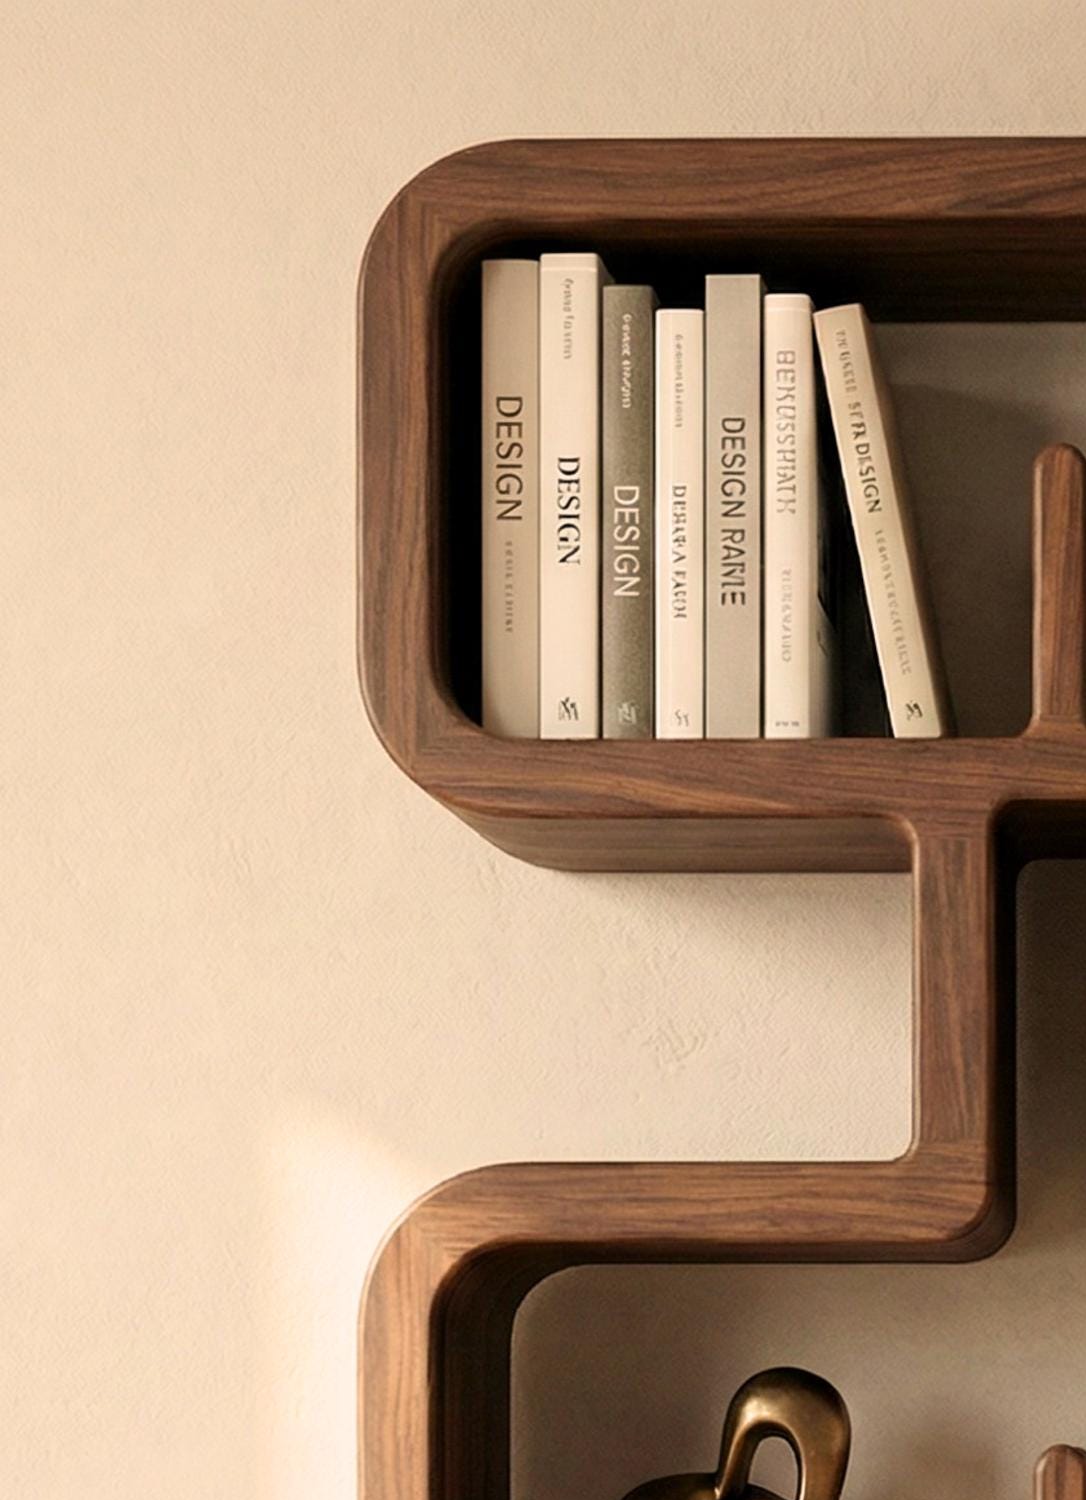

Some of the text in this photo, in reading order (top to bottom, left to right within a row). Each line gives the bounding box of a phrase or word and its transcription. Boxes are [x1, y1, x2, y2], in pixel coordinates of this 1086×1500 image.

[496, 396, 523, 521] DESIGN
[556, 456, 581, 566] DESIGN
[721, 417, 746, 518] DESIGN
[613, 485, 640, 597] DESIGN
